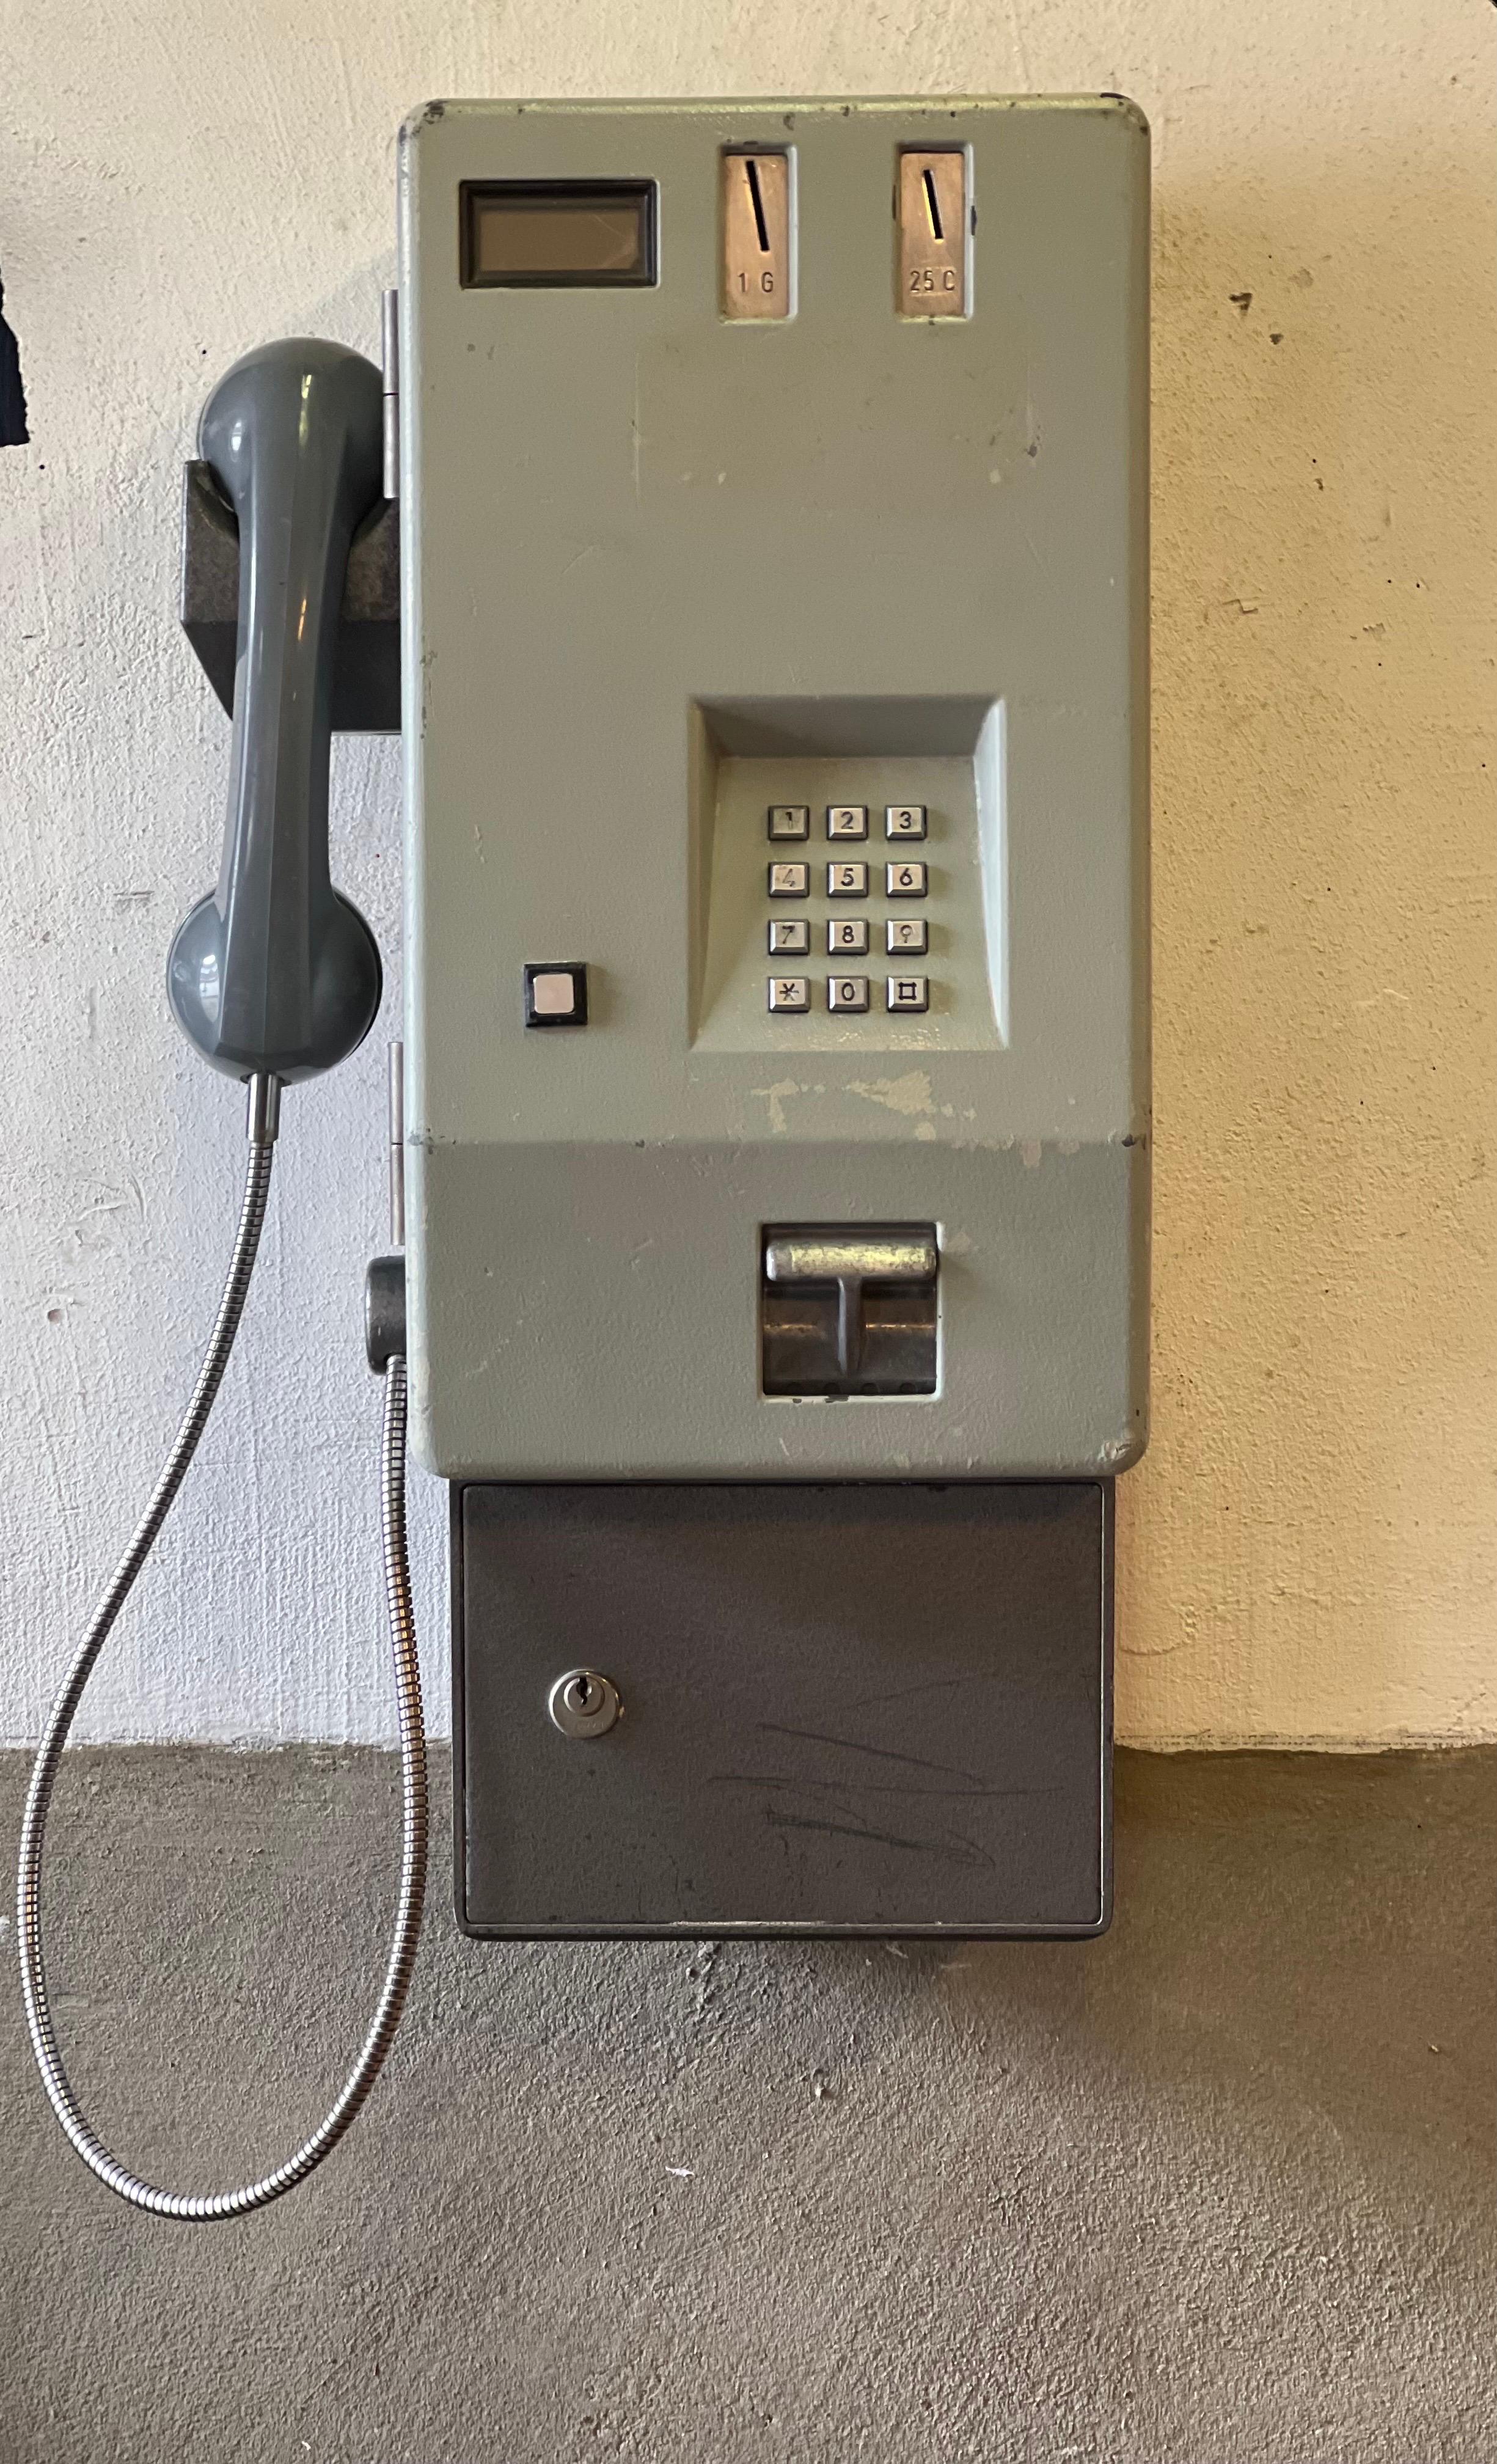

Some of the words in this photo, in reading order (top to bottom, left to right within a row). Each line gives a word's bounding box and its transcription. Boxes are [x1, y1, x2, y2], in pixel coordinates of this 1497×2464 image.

[738, 272, 747, 293] 1
[761, 272, 774, 293] G
[910, 270, 934, 292] 25
[943, 271, 956, 292] C
[786, 811, 793, 829] 1
[841, 812, 854, 829] 2
[899, 811, 912, 829] 3
[782, 868, 796, 887] 4
[841, 868, 854, 886] 5
[899, 868, 913, 886] 6
[782, 925, 795, 944] 7
[841, 925, 855, 944] 8
[841, 982, 855, 1001] 0
